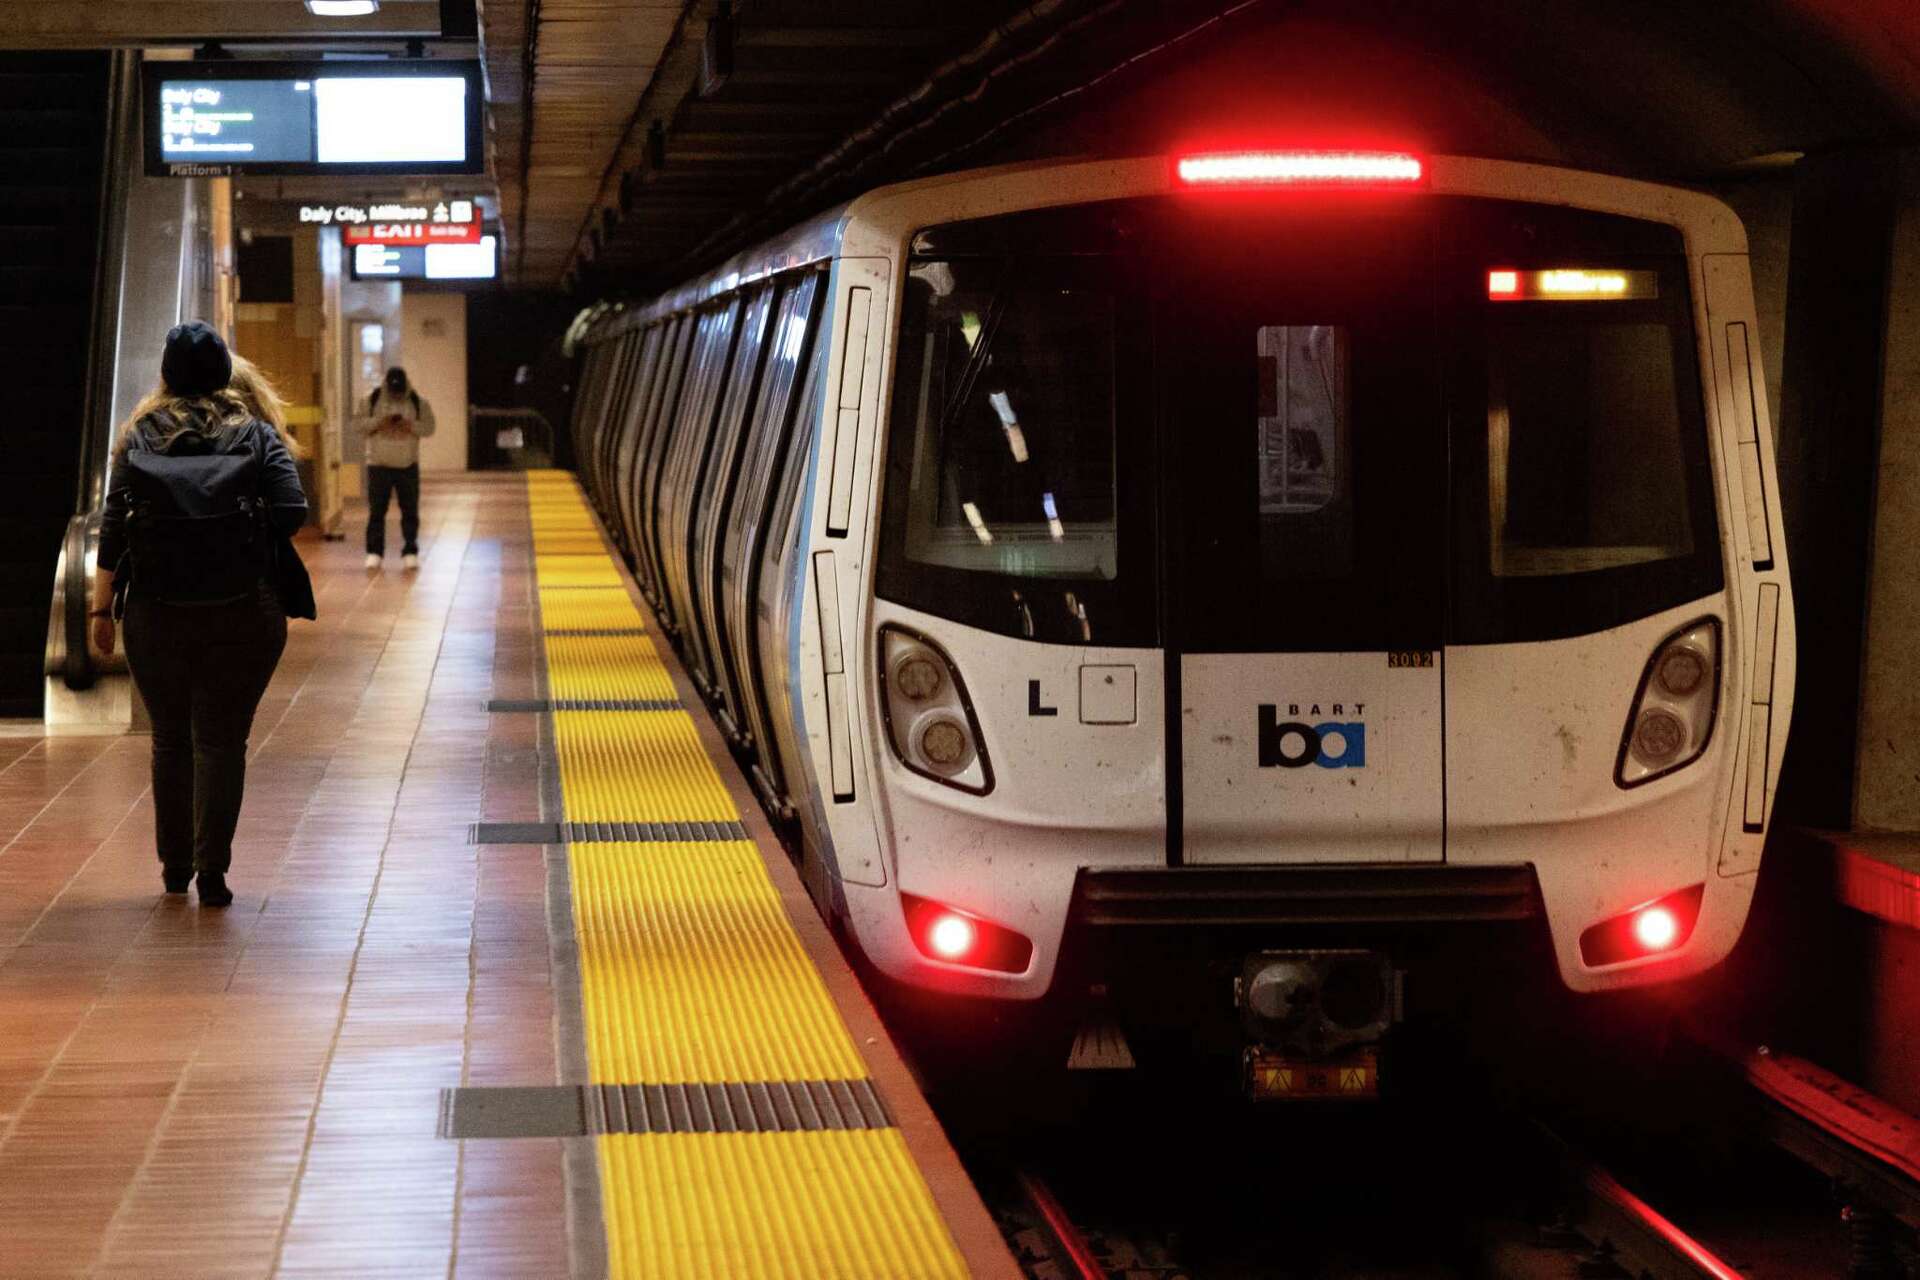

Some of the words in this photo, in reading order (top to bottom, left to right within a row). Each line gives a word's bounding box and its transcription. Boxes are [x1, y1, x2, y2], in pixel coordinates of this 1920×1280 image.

[170, 164, 221, 176] Platform
[300, 206, 333, 224] Daly
[335, 206, 367, 223] City,
[1029, 680, 1058, 716] L
[1288, 704, 1366, 716] BART
